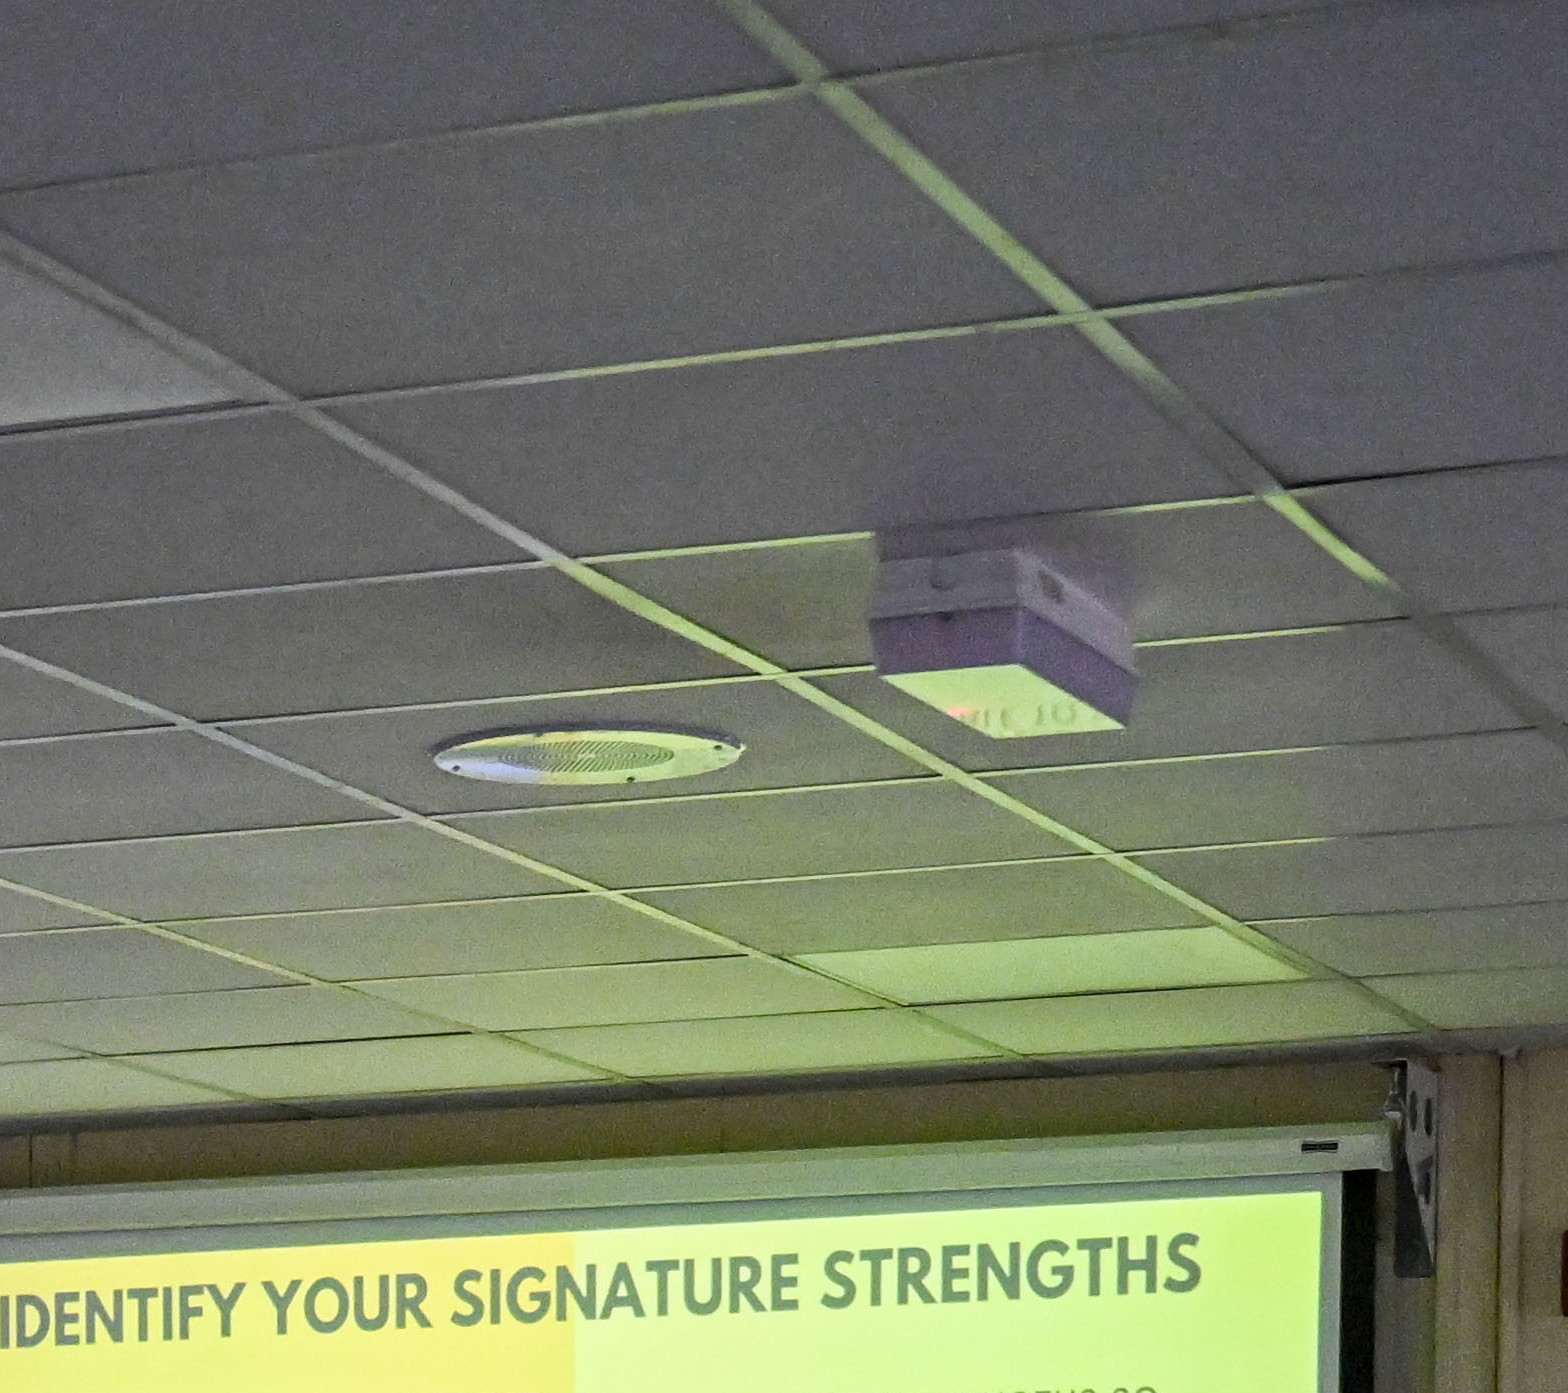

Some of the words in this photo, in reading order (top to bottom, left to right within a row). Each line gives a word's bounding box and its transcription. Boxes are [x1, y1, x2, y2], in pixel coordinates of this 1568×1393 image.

[0, 1281, 247, 1350] IDENTIFY
[260, 1272, 433, 1336] YOUR
[450, 1252, 799, 1328] SIGNATURE
[820, 1232, 1202, 1310] STRENGTHS
